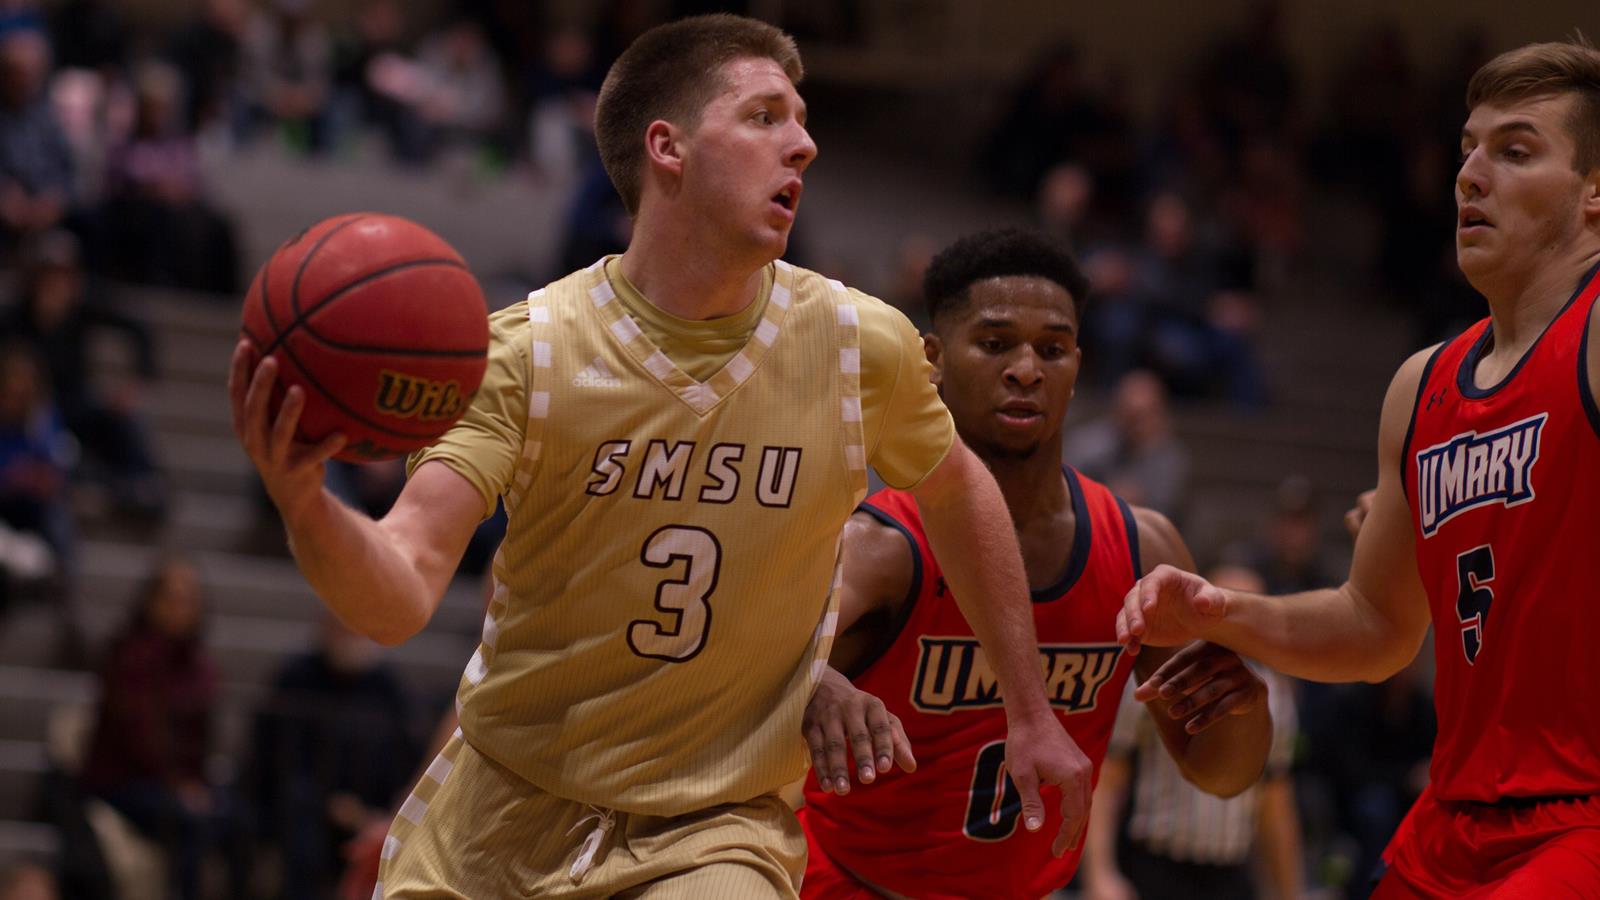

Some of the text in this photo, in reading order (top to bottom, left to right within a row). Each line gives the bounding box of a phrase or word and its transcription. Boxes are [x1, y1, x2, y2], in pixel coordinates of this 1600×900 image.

[572, 375, 623, 388] adidas
[585, 439, 803, 509] SMSU
[1418, 418, 1544, 535] UMARY
[626, 524, 722, 664] 3
[1456, 543, 1495, 666] 5
[913, 638, 1122, 711] UMRY
